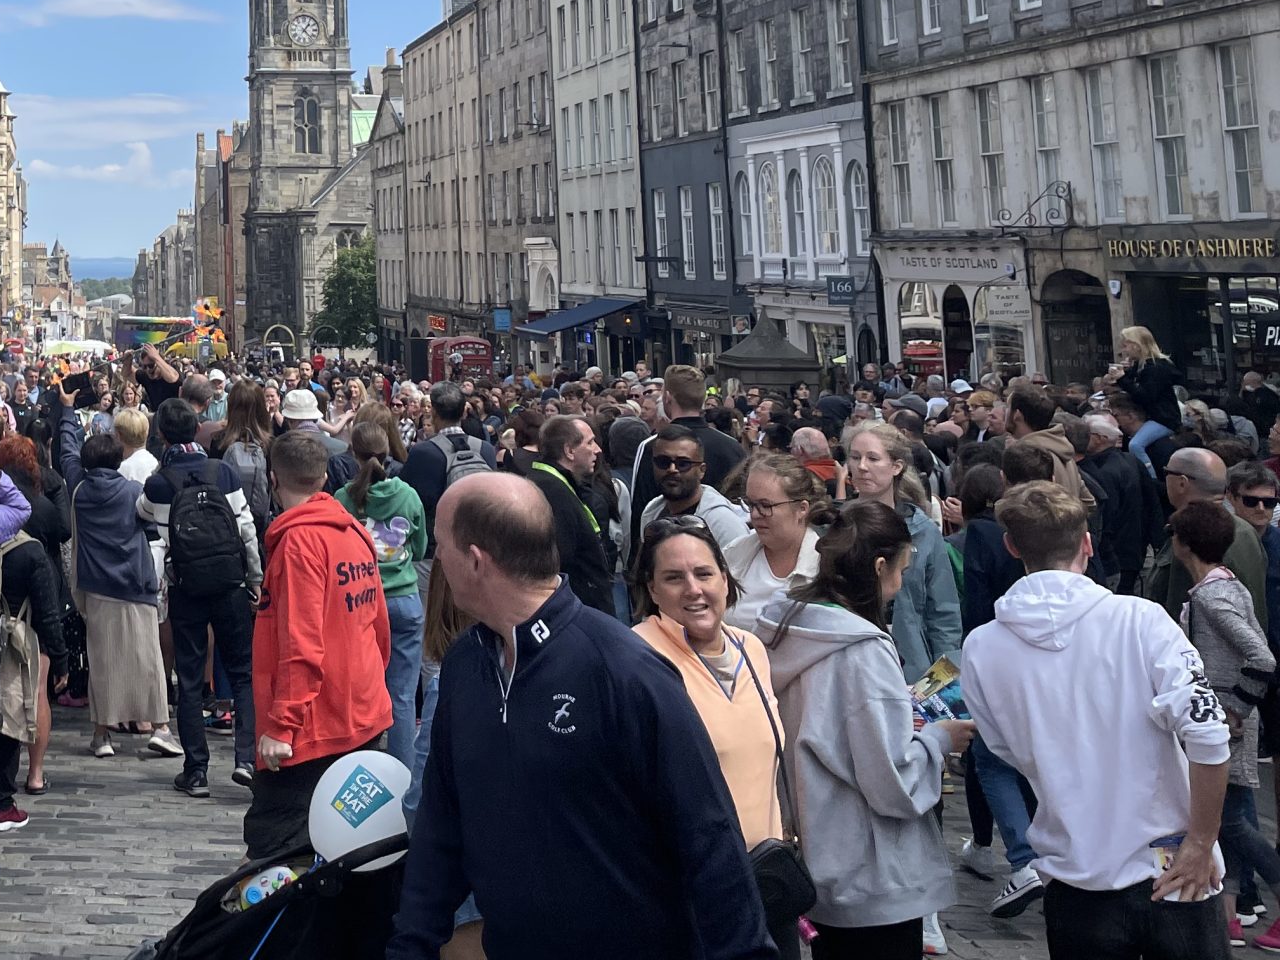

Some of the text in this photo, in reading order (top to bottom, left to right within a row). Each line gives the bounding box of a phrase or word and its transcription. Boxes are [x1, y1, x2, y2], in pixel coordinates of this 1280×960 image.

[1108, 237, 1275, 258] HOUSE OF CASHMERE
[900, 257, 998, 269] TASTE OF SCOTLAND
[830, 281, 852, 293] 166
[1264, 326, 1280, 346] PI
[336, 561, 375, 586] Stree
[349, 782, 373, 807] IN THE
[355, 774, 383, 799] CAT
[340, 789, 367, 814] HAT
